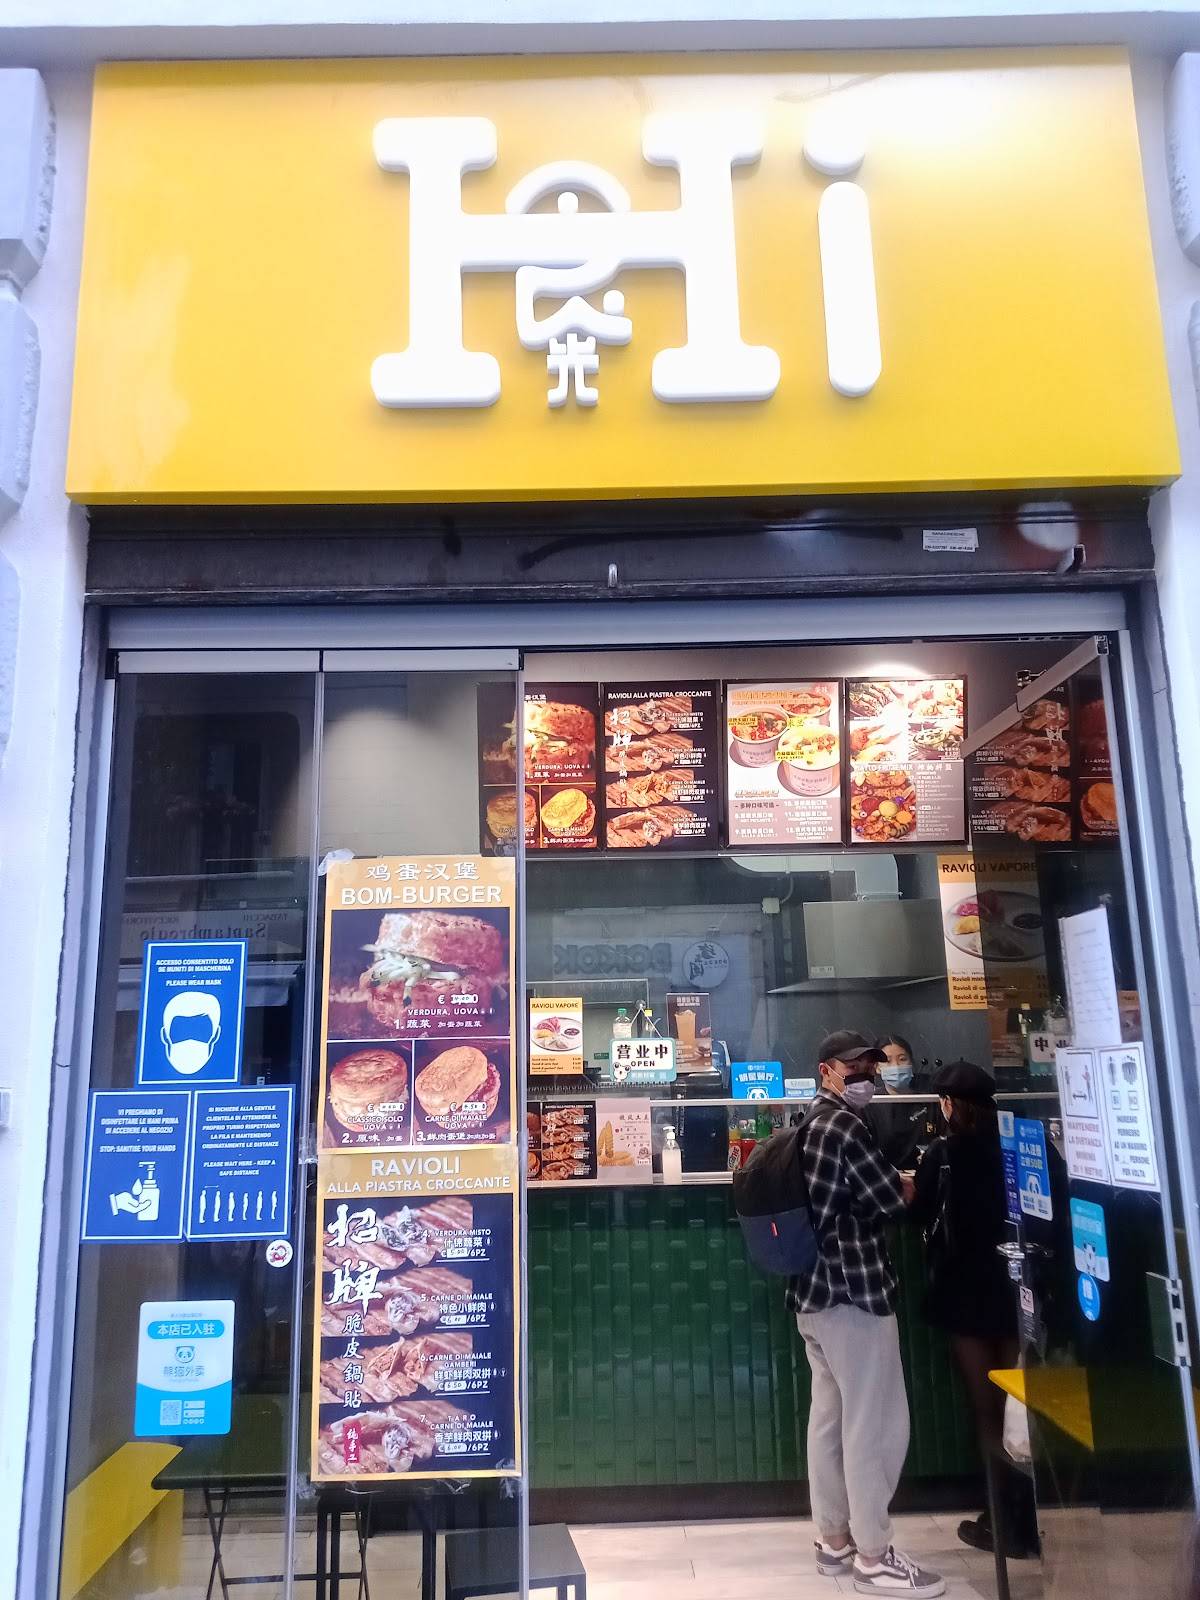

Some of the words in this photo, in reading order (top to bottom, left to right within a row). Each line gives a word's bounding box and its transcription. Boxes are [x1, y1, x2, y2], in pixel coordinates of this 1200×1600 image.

[367, 862, 480, 881] 鸡蛋汉堡
[942, 863, 987, 873] RAVIOLI
[989, 862, 1037, 873] VAPORE
[341, 885, 502, 905] BOM-BURGER
[394, 1019, 404, 1030] 1.
[407, 1019, 431, 1029] 蔬菜
[617, 1044, 668, 1059] 营业中
[347, 1115, 382, 1123] CLASSICO
[342, 1133, 353, 1143] 2.
[356, 1134, 380, 1143] 原味
[417, 1131, 426, 1141] 3.
[371, 1156, 460, 1176] RAVIOLI
[327, 1182, 362, 1193] ALLA
[365, 1180, 422, 1192] PIASTRA
[426, 1176, 511, 1190] CROCCANTE
[434, 1229, 467, 1237] VERDURA
[324, 1203, 383, 1318] 招牌
[440, 1302, 487, 1314] 特色小鲜肉
[157, 1323, 215, 1336] 本店已入驻
[464, 1352, 491, 1360] MAIALE
[163, 1366, 205, 1377] 熊猫外卖
[434, 1368, 491, 1380] 鲜虾鲜肉双拼
[466, 1421, 493, 1429] MAIALE
[434, 1430, 492, 1442] 香芋鲜肉双拼
